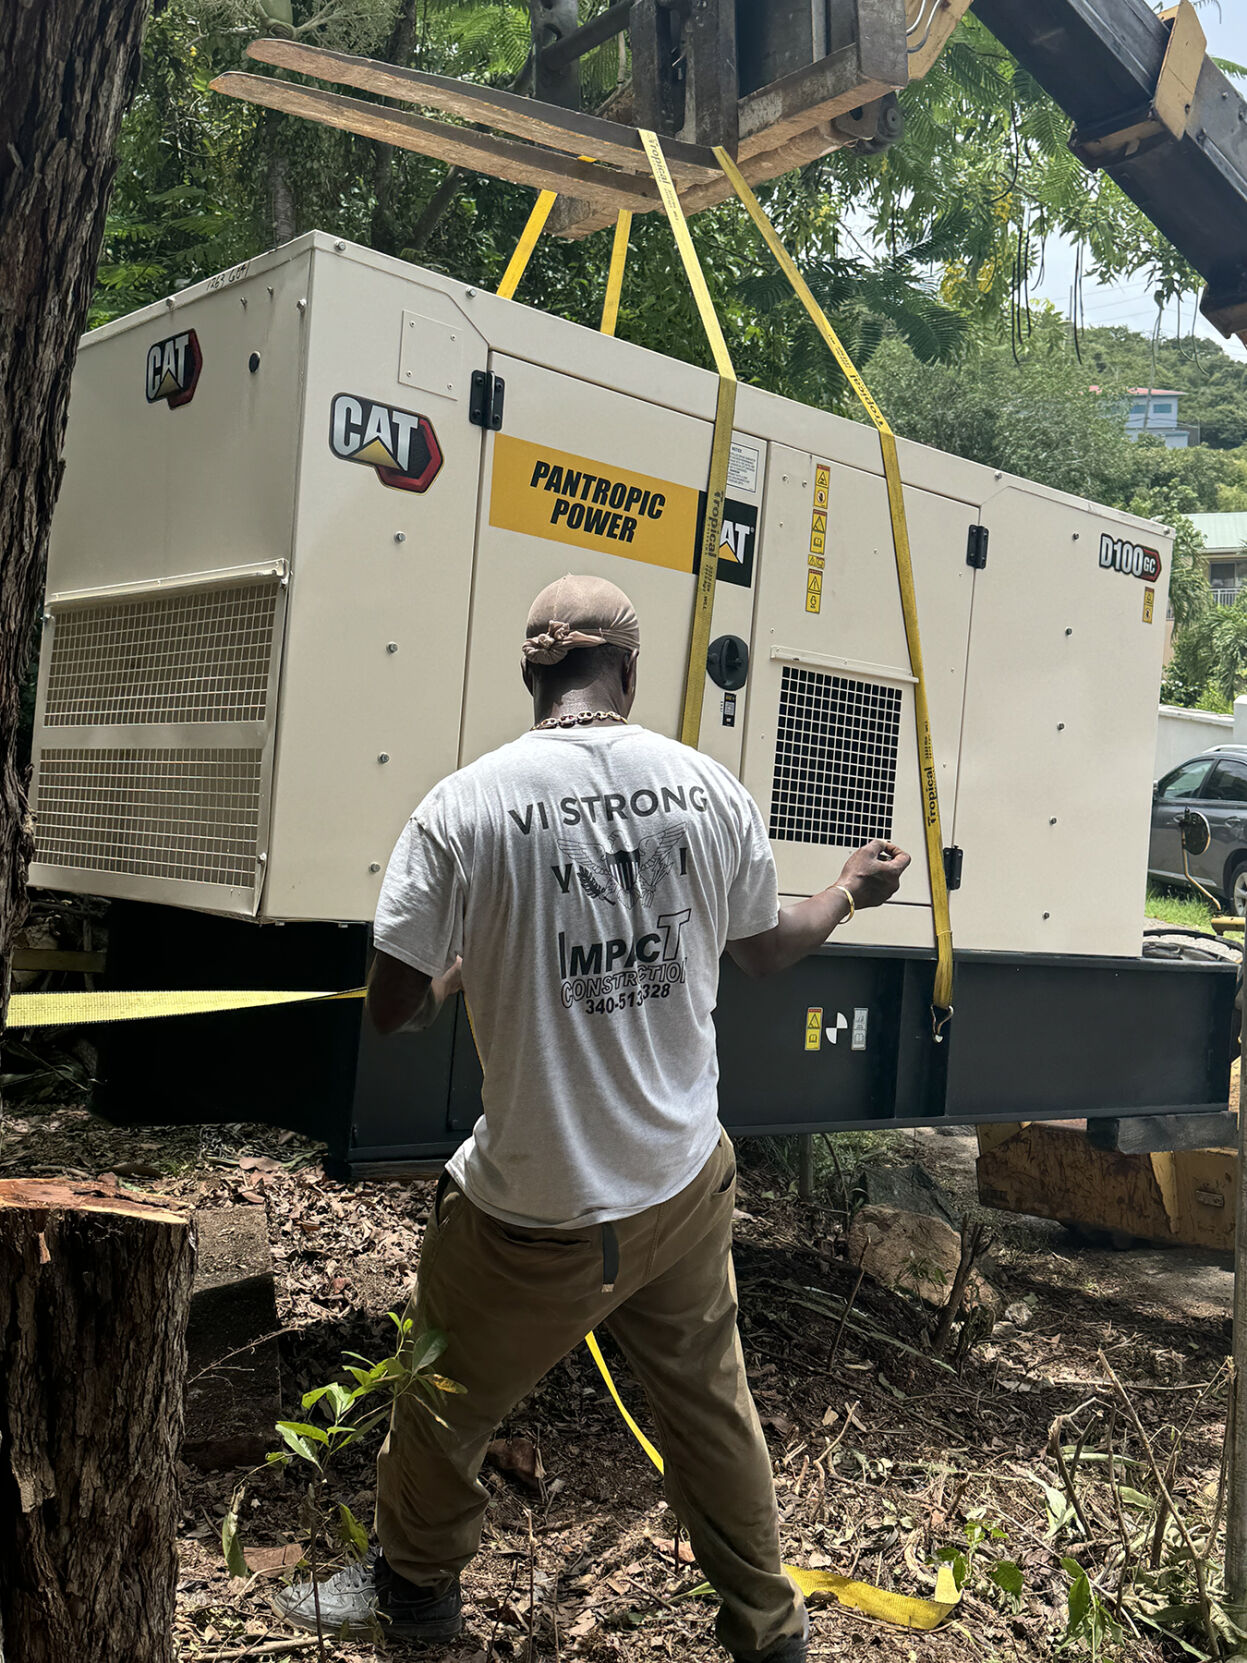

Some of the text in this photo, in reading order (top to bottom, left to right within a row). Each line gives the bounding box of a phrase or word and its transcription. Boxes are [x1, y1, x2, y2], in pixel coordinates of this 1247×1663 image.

[148, 334, 190, 398] CAT
[333, 395, 418, 471] CAT
[529, 460, 666, 520] PANTROPIC
[550, 498, 638, 543] POWER
[708, 490, 724, 558] Tropical
[719, 519, 750, 564] AT
[1099, 533, 1156, 578] D100 GC
[508, 785, 708, 836] VI STRONG
[923, 766, 937, 827] Tropical
[551, 863, 573, 894] V
[558, 908, 692, 979] IMPACT
